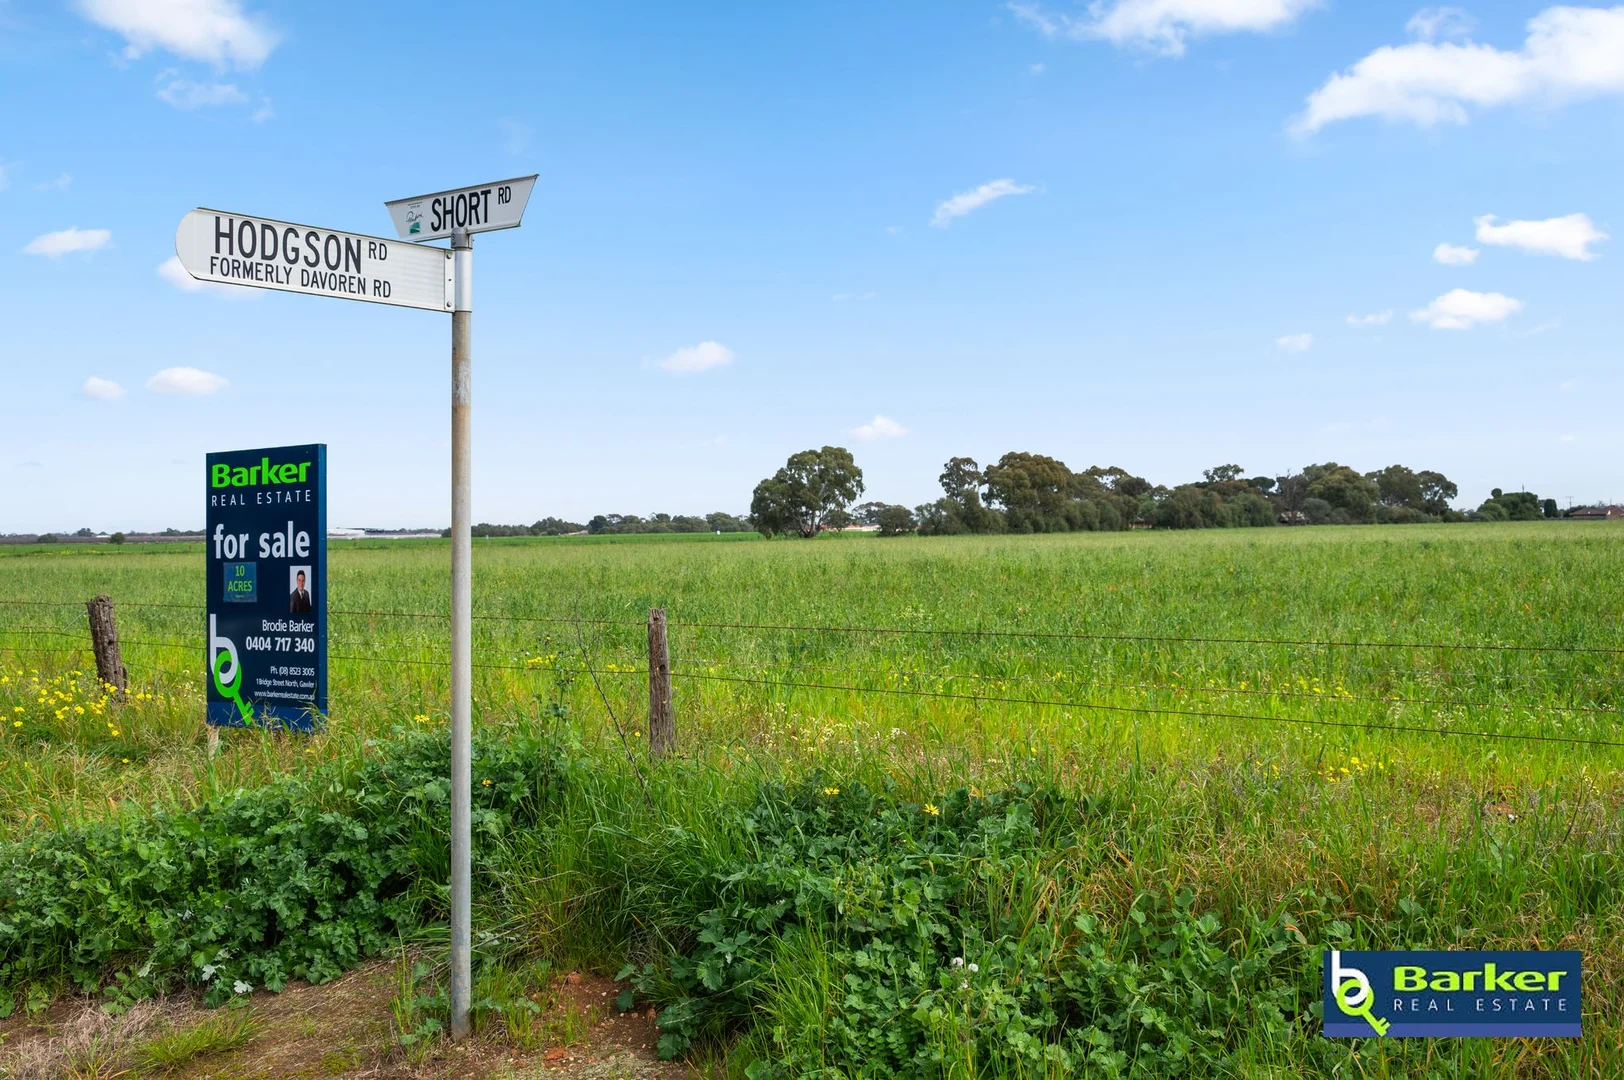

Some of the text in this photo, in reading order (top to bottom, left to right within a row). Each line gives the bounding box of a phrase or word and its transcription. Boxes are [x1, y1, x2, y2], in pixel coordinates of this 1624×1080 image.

[431, 186, 511, 232] SHORT RD
[215, 216, 388, 274] HODGSON RD
[210, 256, 391, 298] FORMERLY DAVOREN RD
[212, 457, 311, 488] Barker
[211, 489, 311, 507] REAL ESTATE
[213, 520, 310, 559] for sale
[235, 565, 245, 577] 10
[228, 580, 253, 592] ACRES
[262, 619, 314, 632] Brodie Barker
[245, 636, 315, 652] 0404 717 340
[279, 666, 288, 676] (08)
[289, 666, 301, 676] 8523
